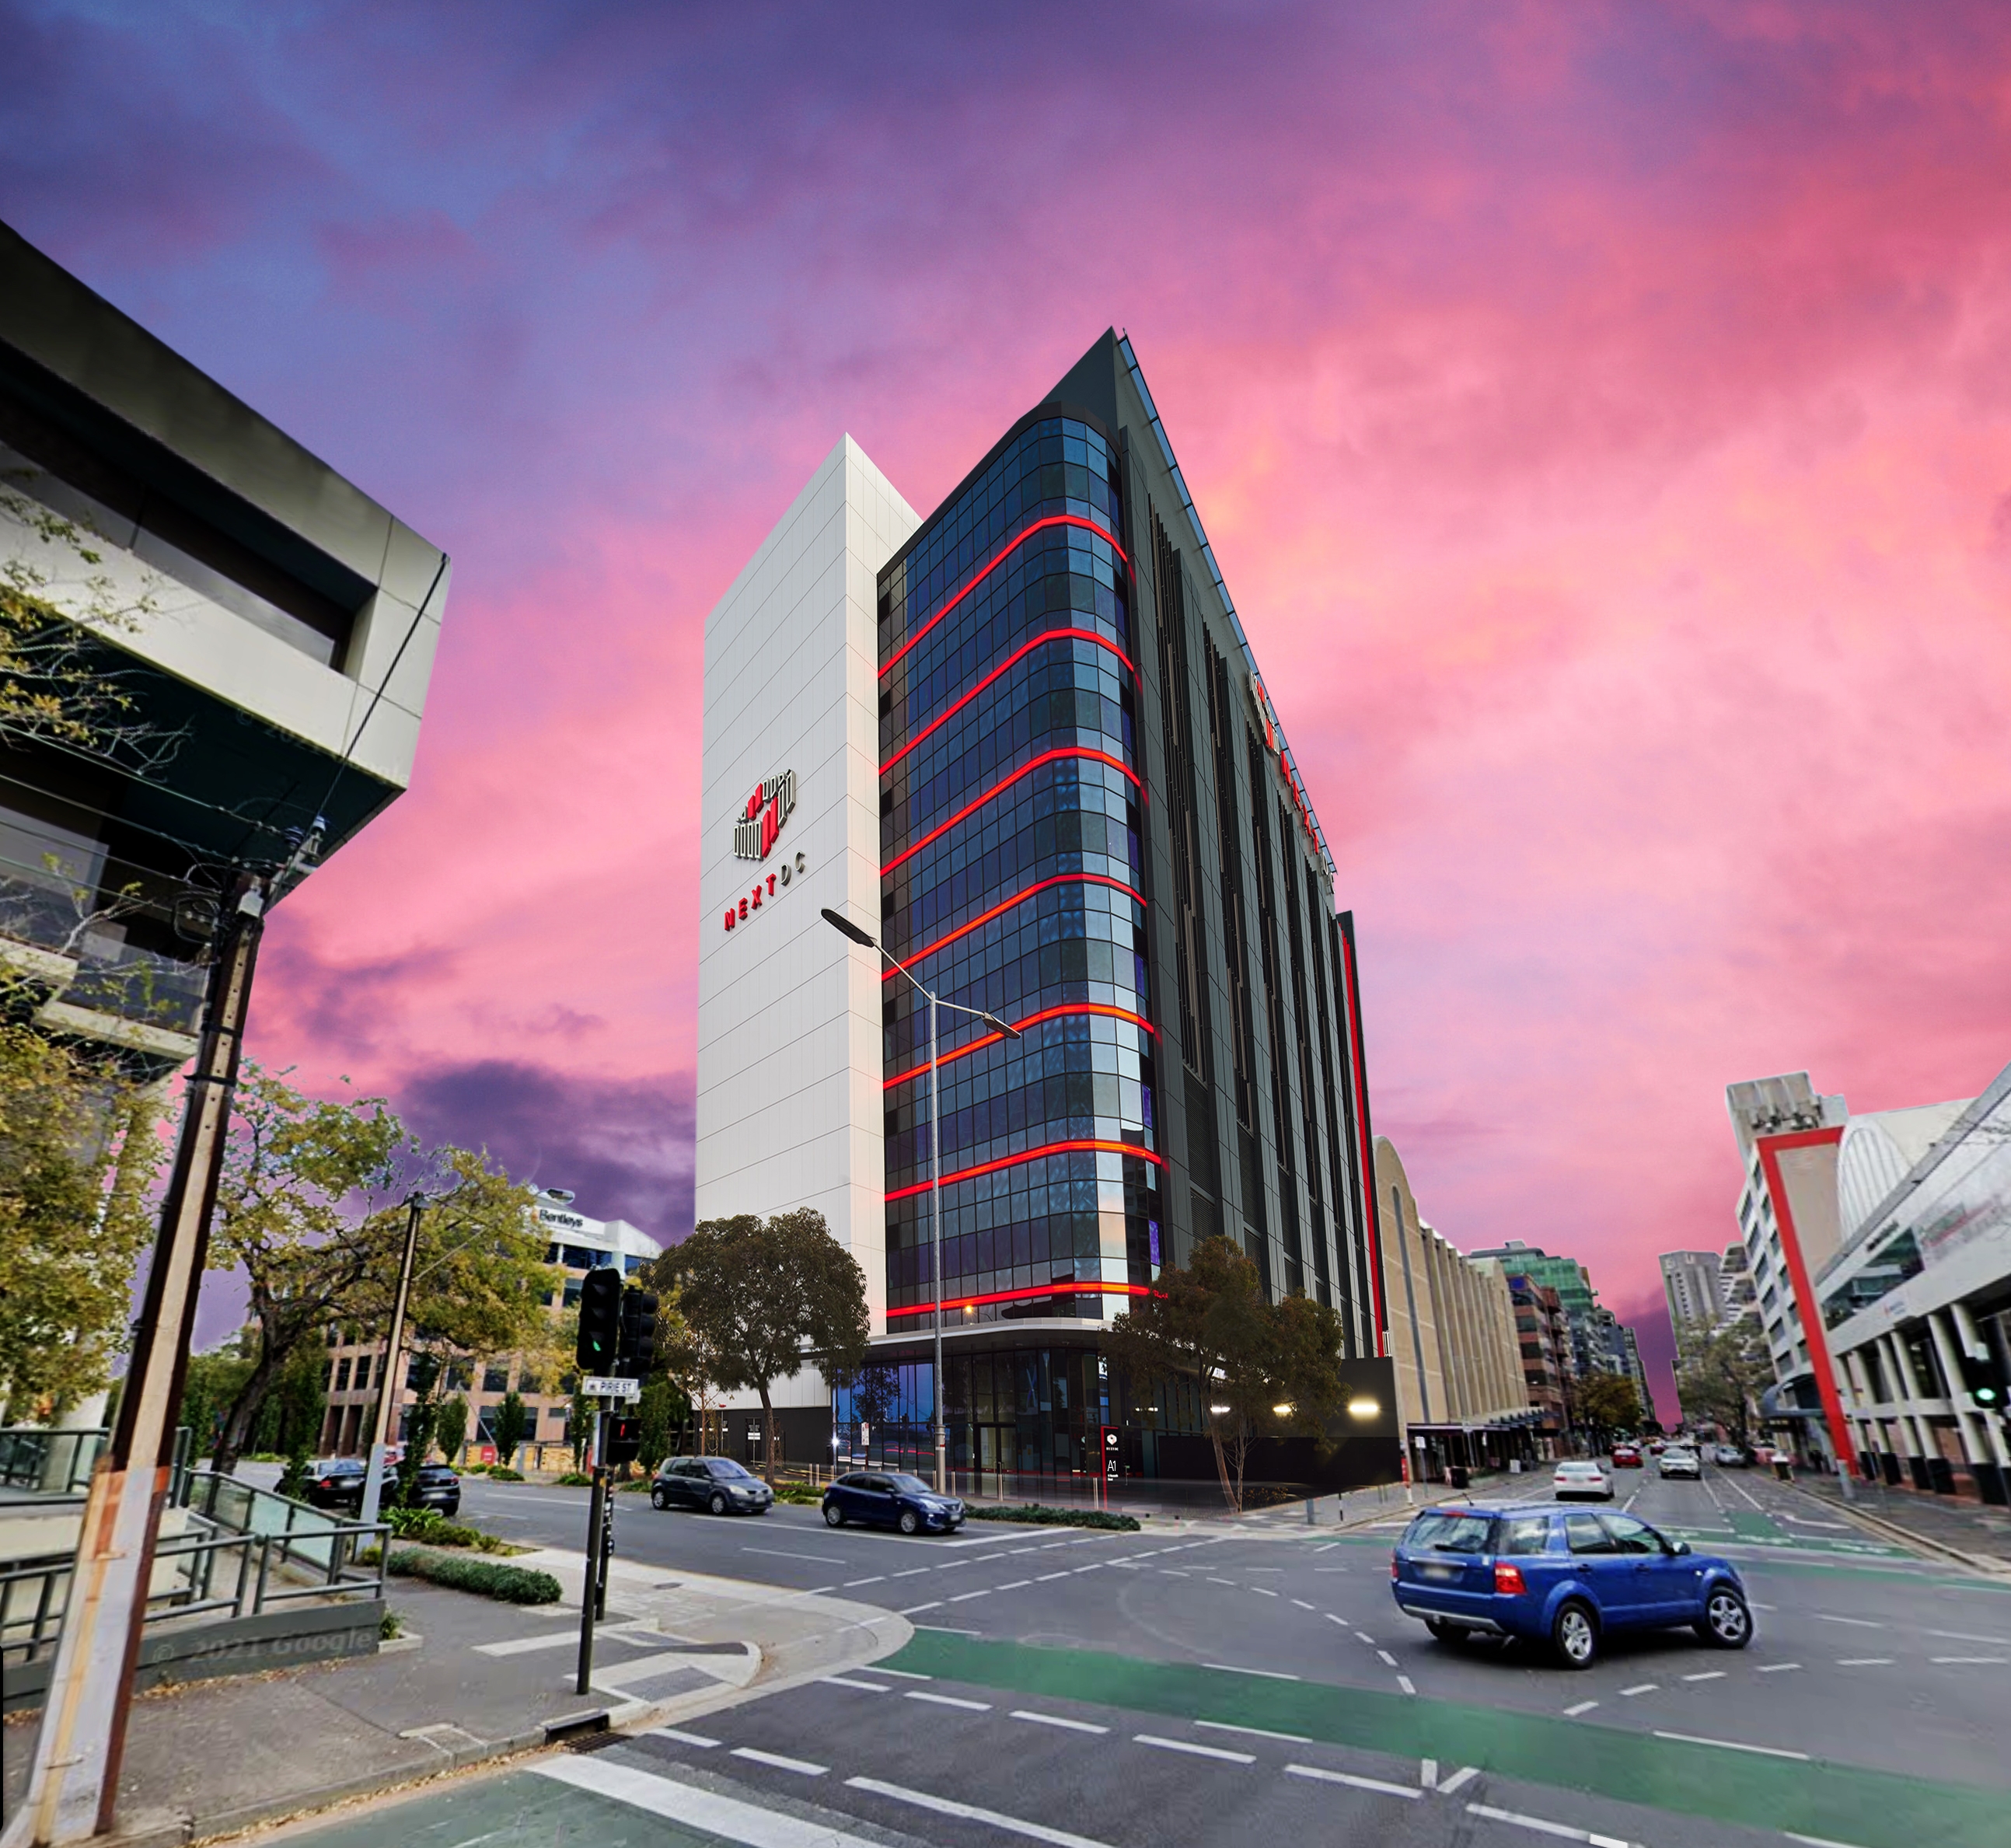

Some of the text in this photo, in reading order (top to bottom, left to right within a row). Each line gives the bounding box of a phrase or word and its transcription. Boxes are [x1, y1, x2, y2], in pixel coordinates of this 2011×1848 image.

[1280, 750, 1335, 894] NEXTDC
[724, 850, 806, 931] NEXTDC
[539, 1209, 583, 1228] Bentleys
[1107, 1459, 1116, 1472] A1
